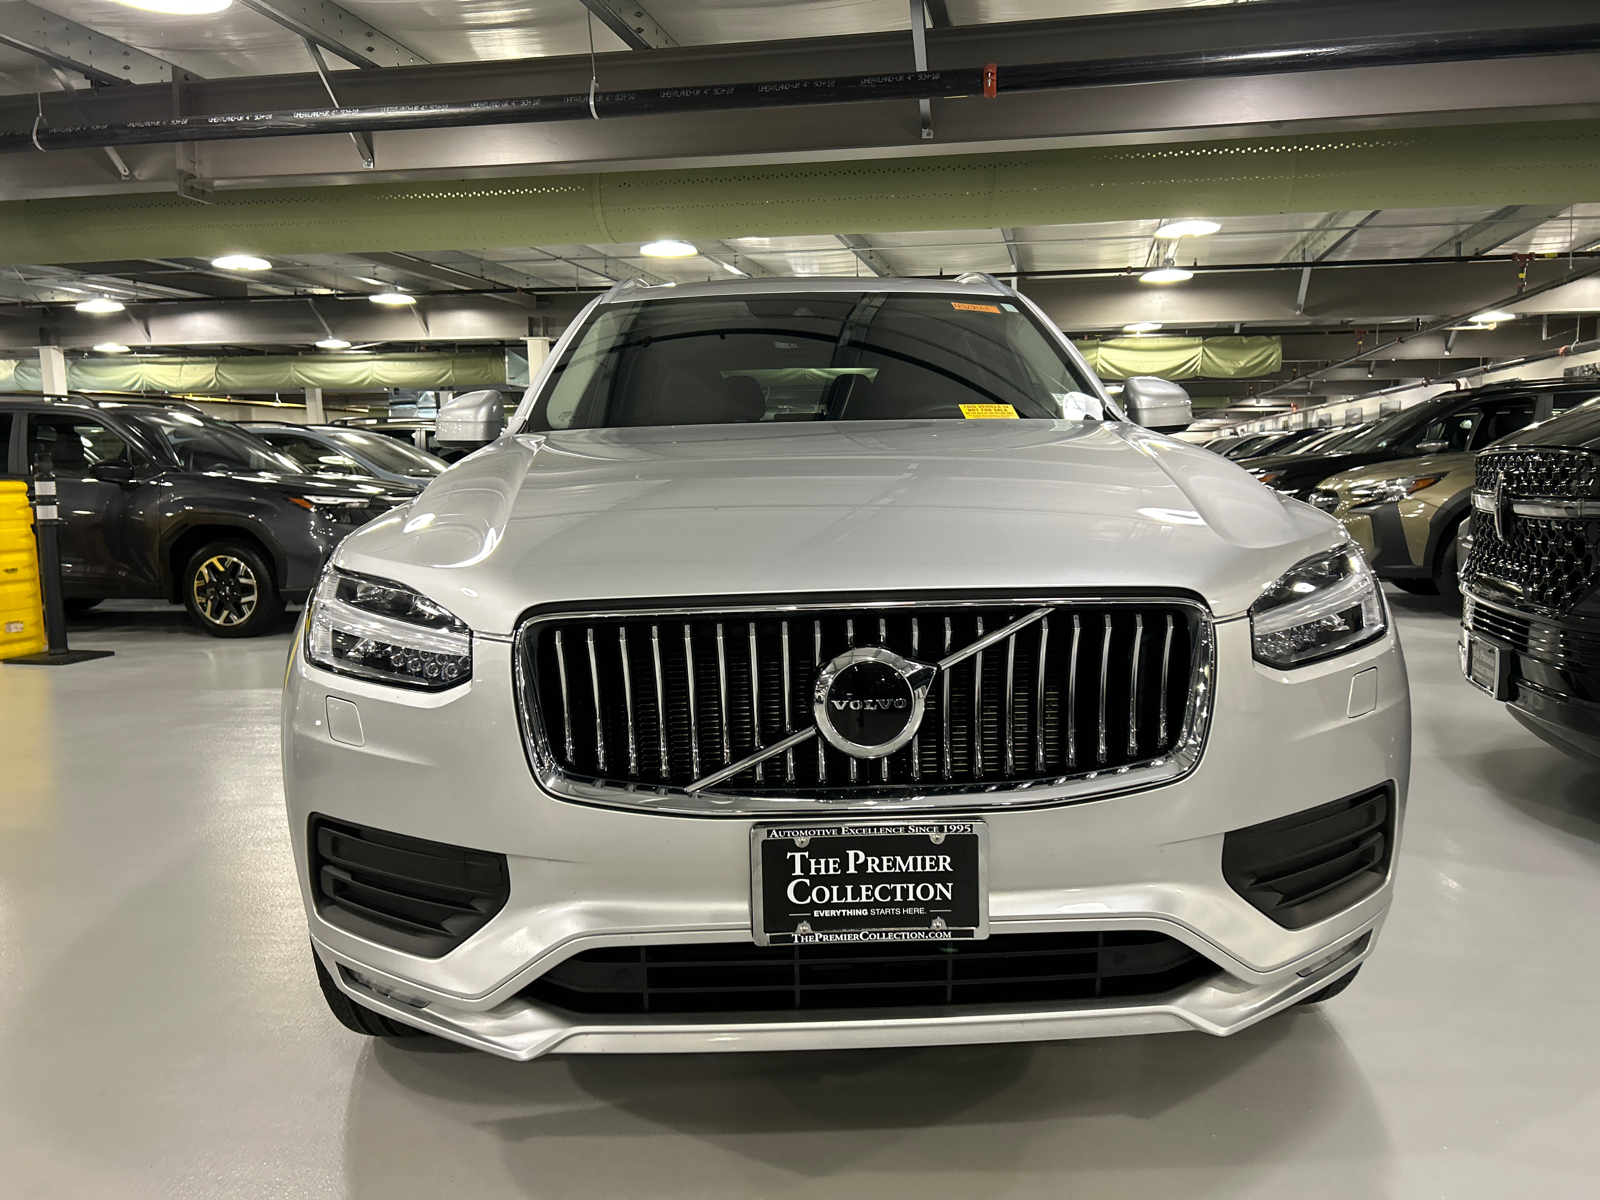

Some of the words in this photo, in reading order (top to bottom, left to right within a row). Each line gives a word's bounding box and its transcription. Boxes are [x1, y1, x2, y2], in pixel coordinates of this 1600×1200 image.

[831, 698, 907, 711] VOLVO
[769, 826, 838, 838] AUTOMOTIVE
[841, 825, 905, 836] EXCELLENCE
[907, 825, 939, 834] SINCE
[943, 824, 972, 833] 1995
[786, 851, 841, 876] THE
[845, 850, 953, 875] PREMIER
[786, 878, 954, 905] COLLECTION
[813, 908, 869, 917] EVERYTHING
[870, 907, 902, 916] STARTS
[902, 907, 927, 915] HERE.
